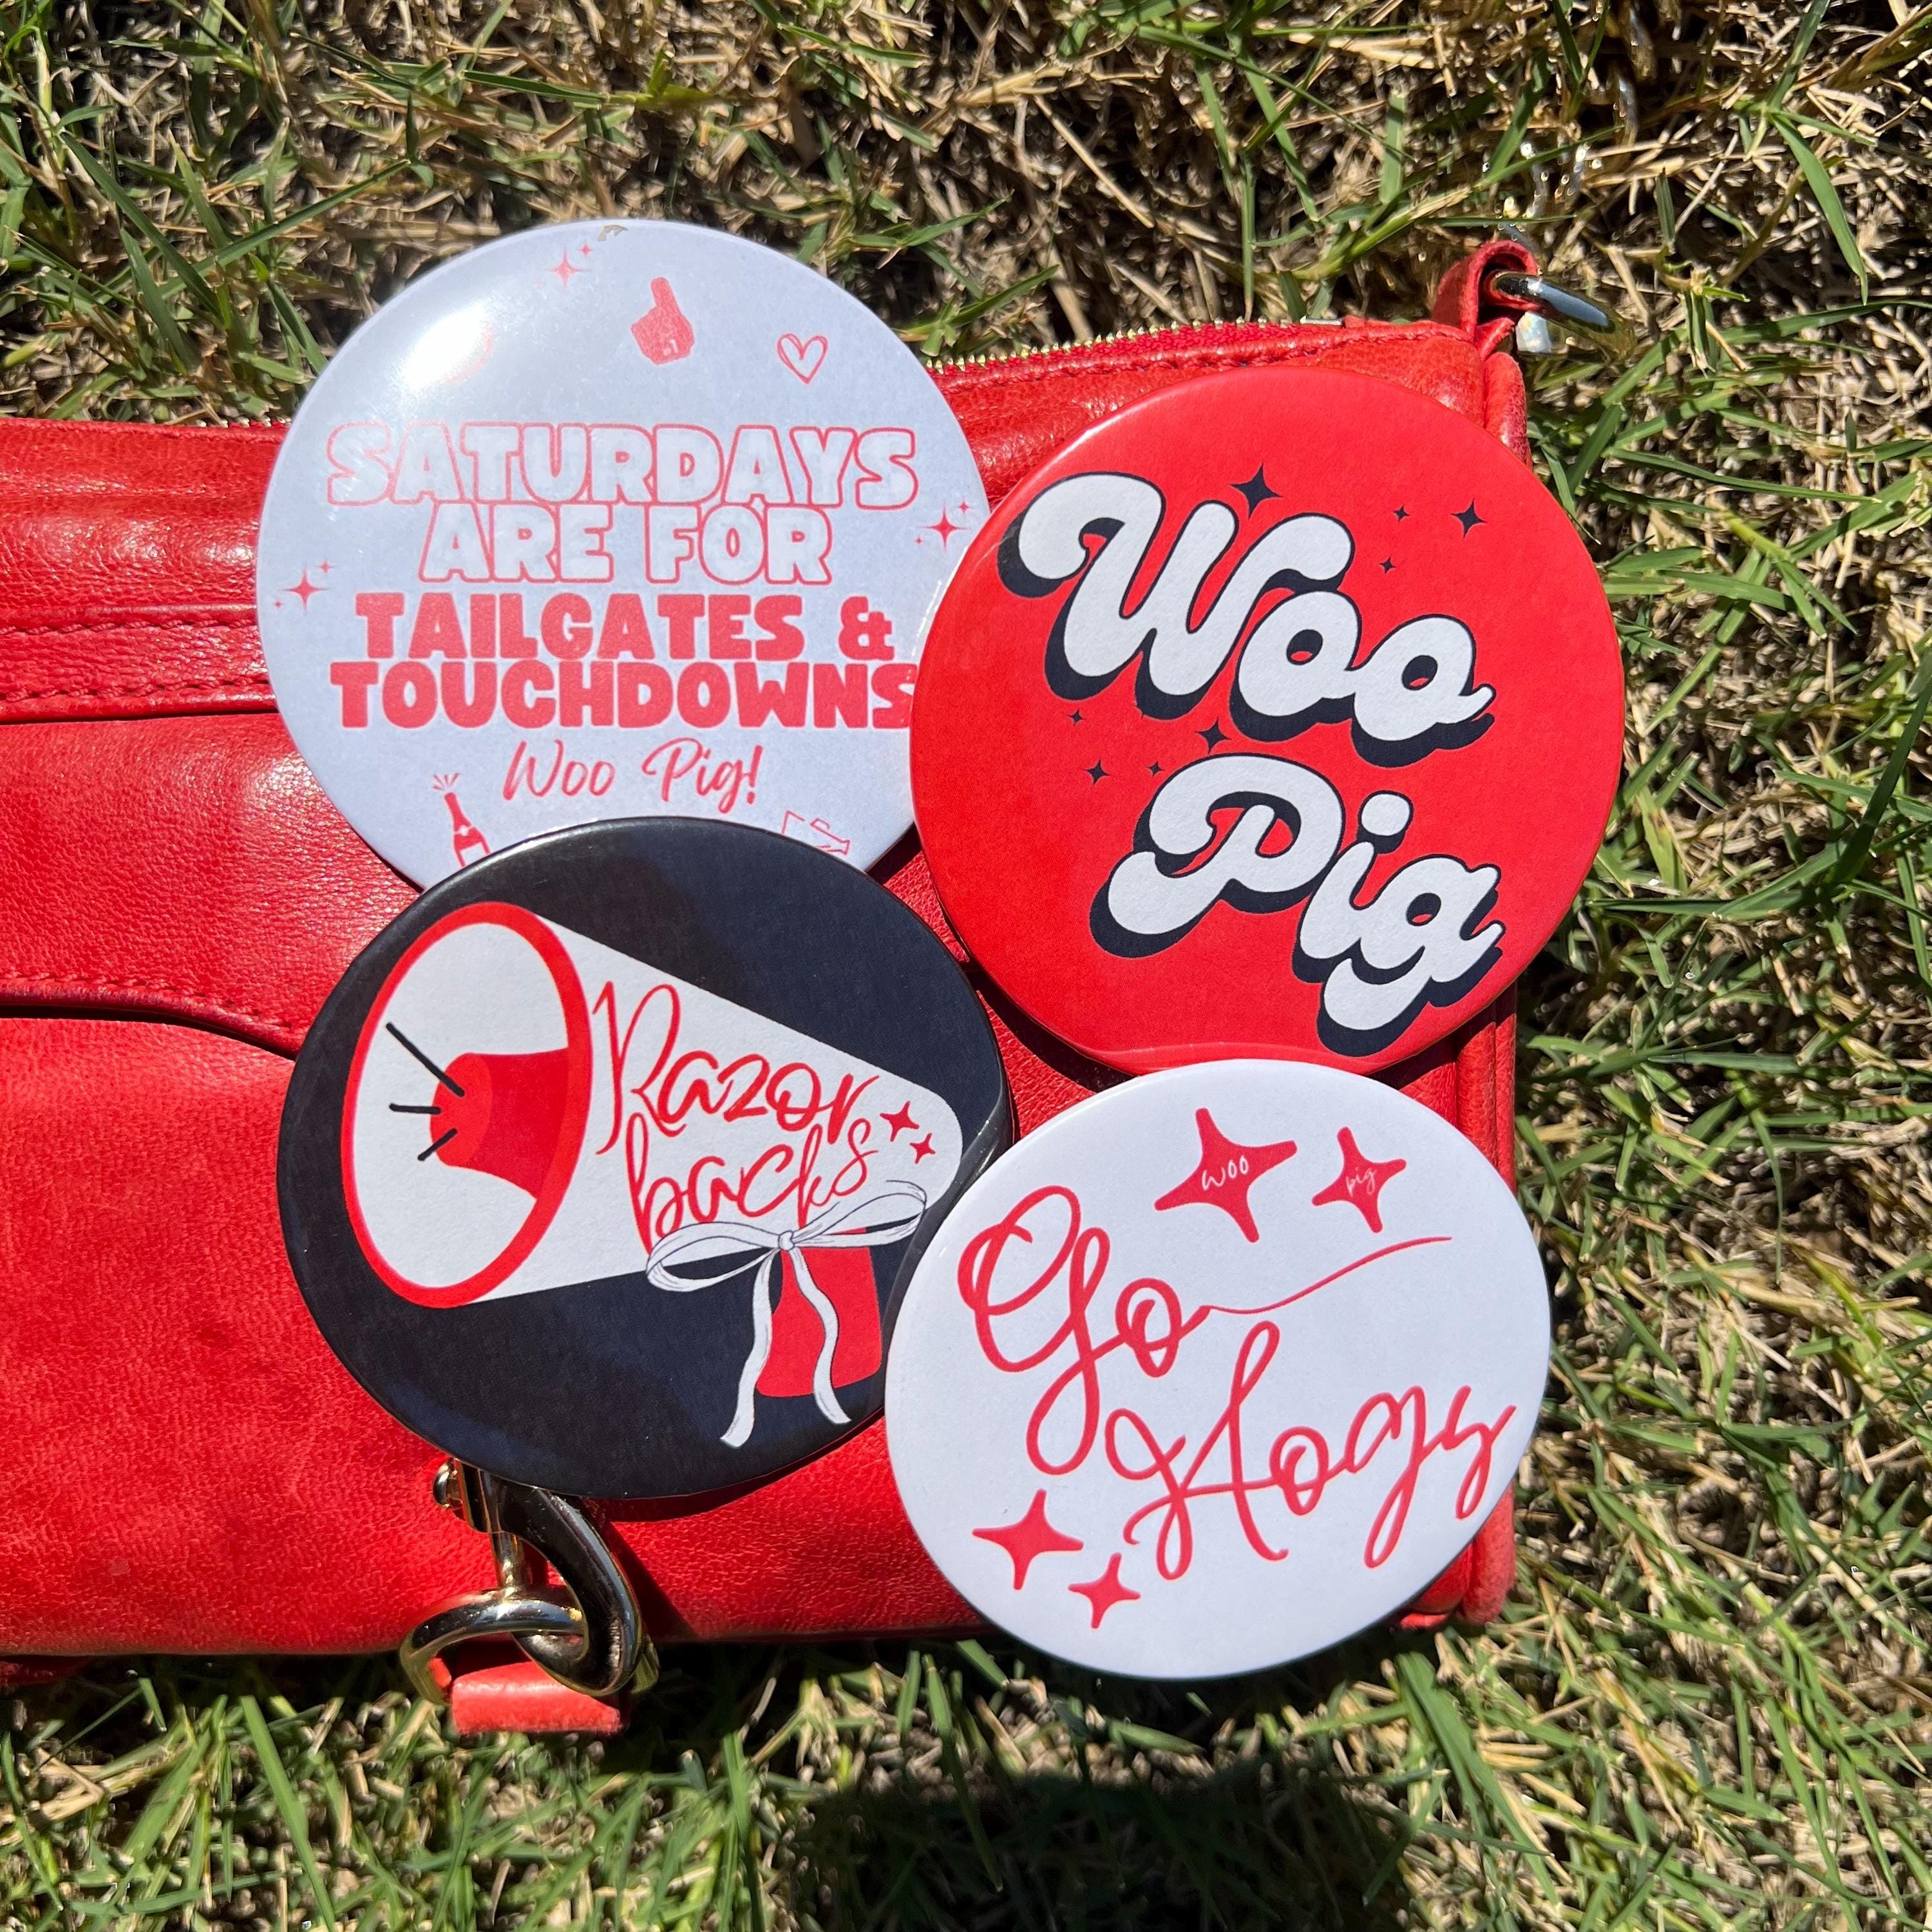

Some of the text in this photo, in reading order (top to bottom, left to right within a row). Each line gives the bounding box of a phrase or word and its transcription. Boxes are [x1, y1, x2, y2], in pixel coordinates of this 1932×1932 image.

[327, 422, 918, 509] SATURDAYS
[419, 498, 833, 585] ARE FOR
[355, 592, 895, 662] TAILGATES &
[997, 471, 1497, 768] Woo
[330, 662, 917, 728] TOUCHDOWNS
[502, 737, 764, 814] Woo Pig!
[1089, 753, 1506, 1057] Pig
[592, 980, 879, 1155] Razor
[625, 1112, 878, 1257] backs
[1346, 1166, 1378, 1198] pig
[957, 1184, 1453, 1477] Go
[1104, 1319, 1517, 1581] Hogs
